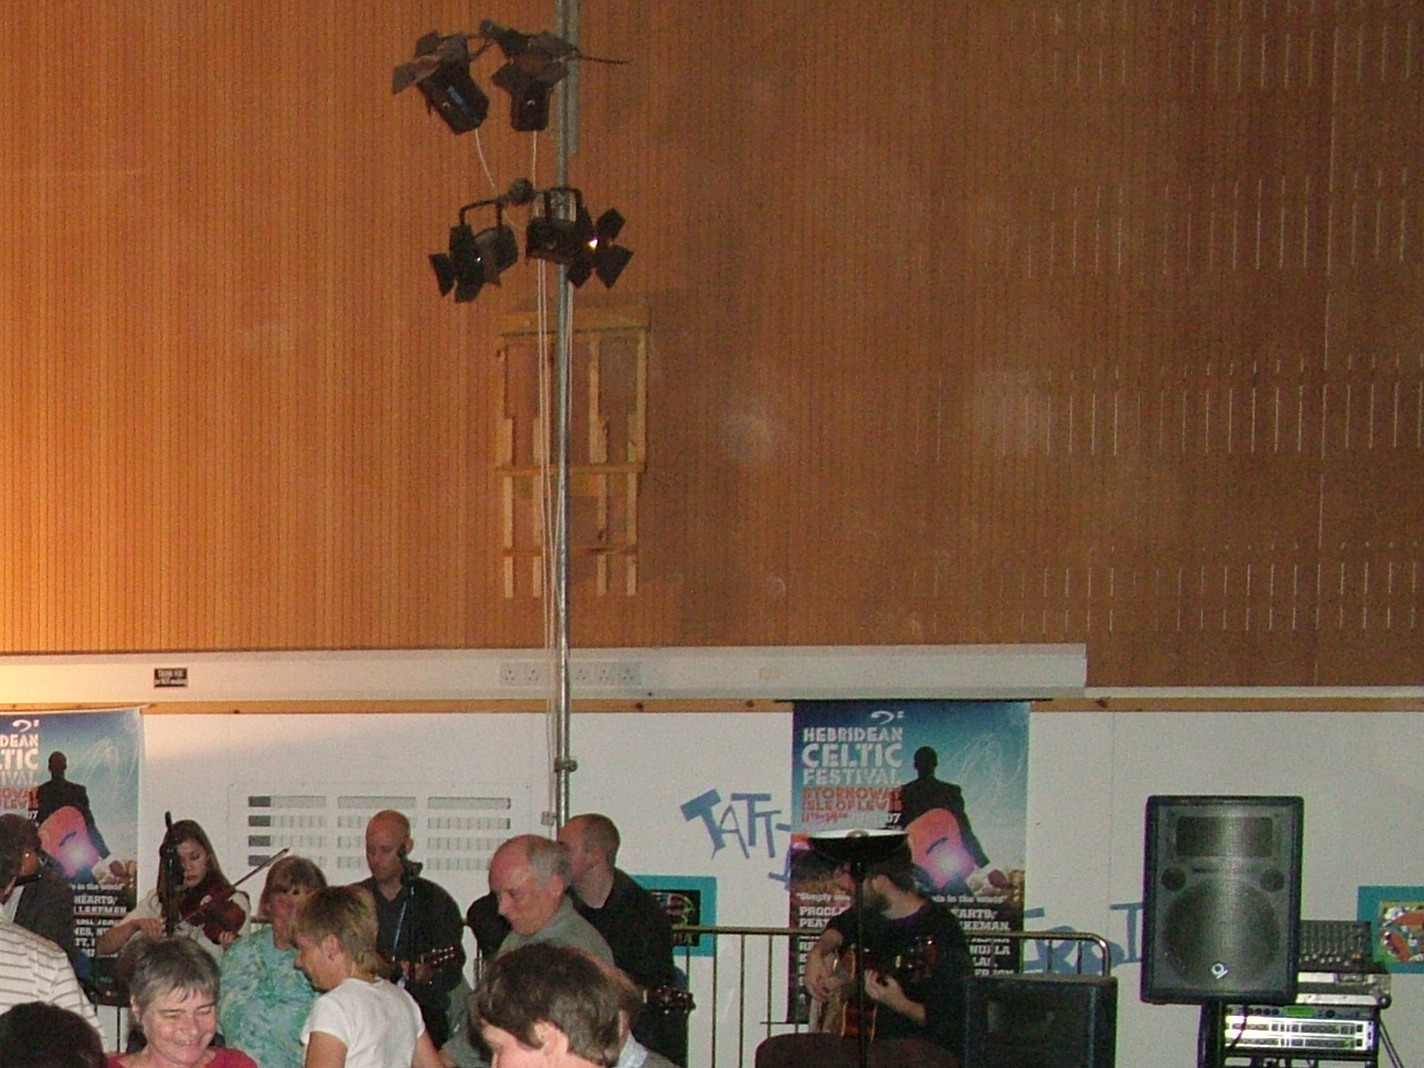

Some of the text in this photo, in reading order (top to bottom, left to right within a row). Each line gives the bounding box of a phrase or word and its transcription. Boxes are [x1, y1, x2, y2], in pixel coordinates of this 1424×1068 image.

[802, 727, 903, 742] HEBRIDEAN
[802, 743, 903, 768] CELTIC
[803, 768, 900, 785] FESTIVAL
